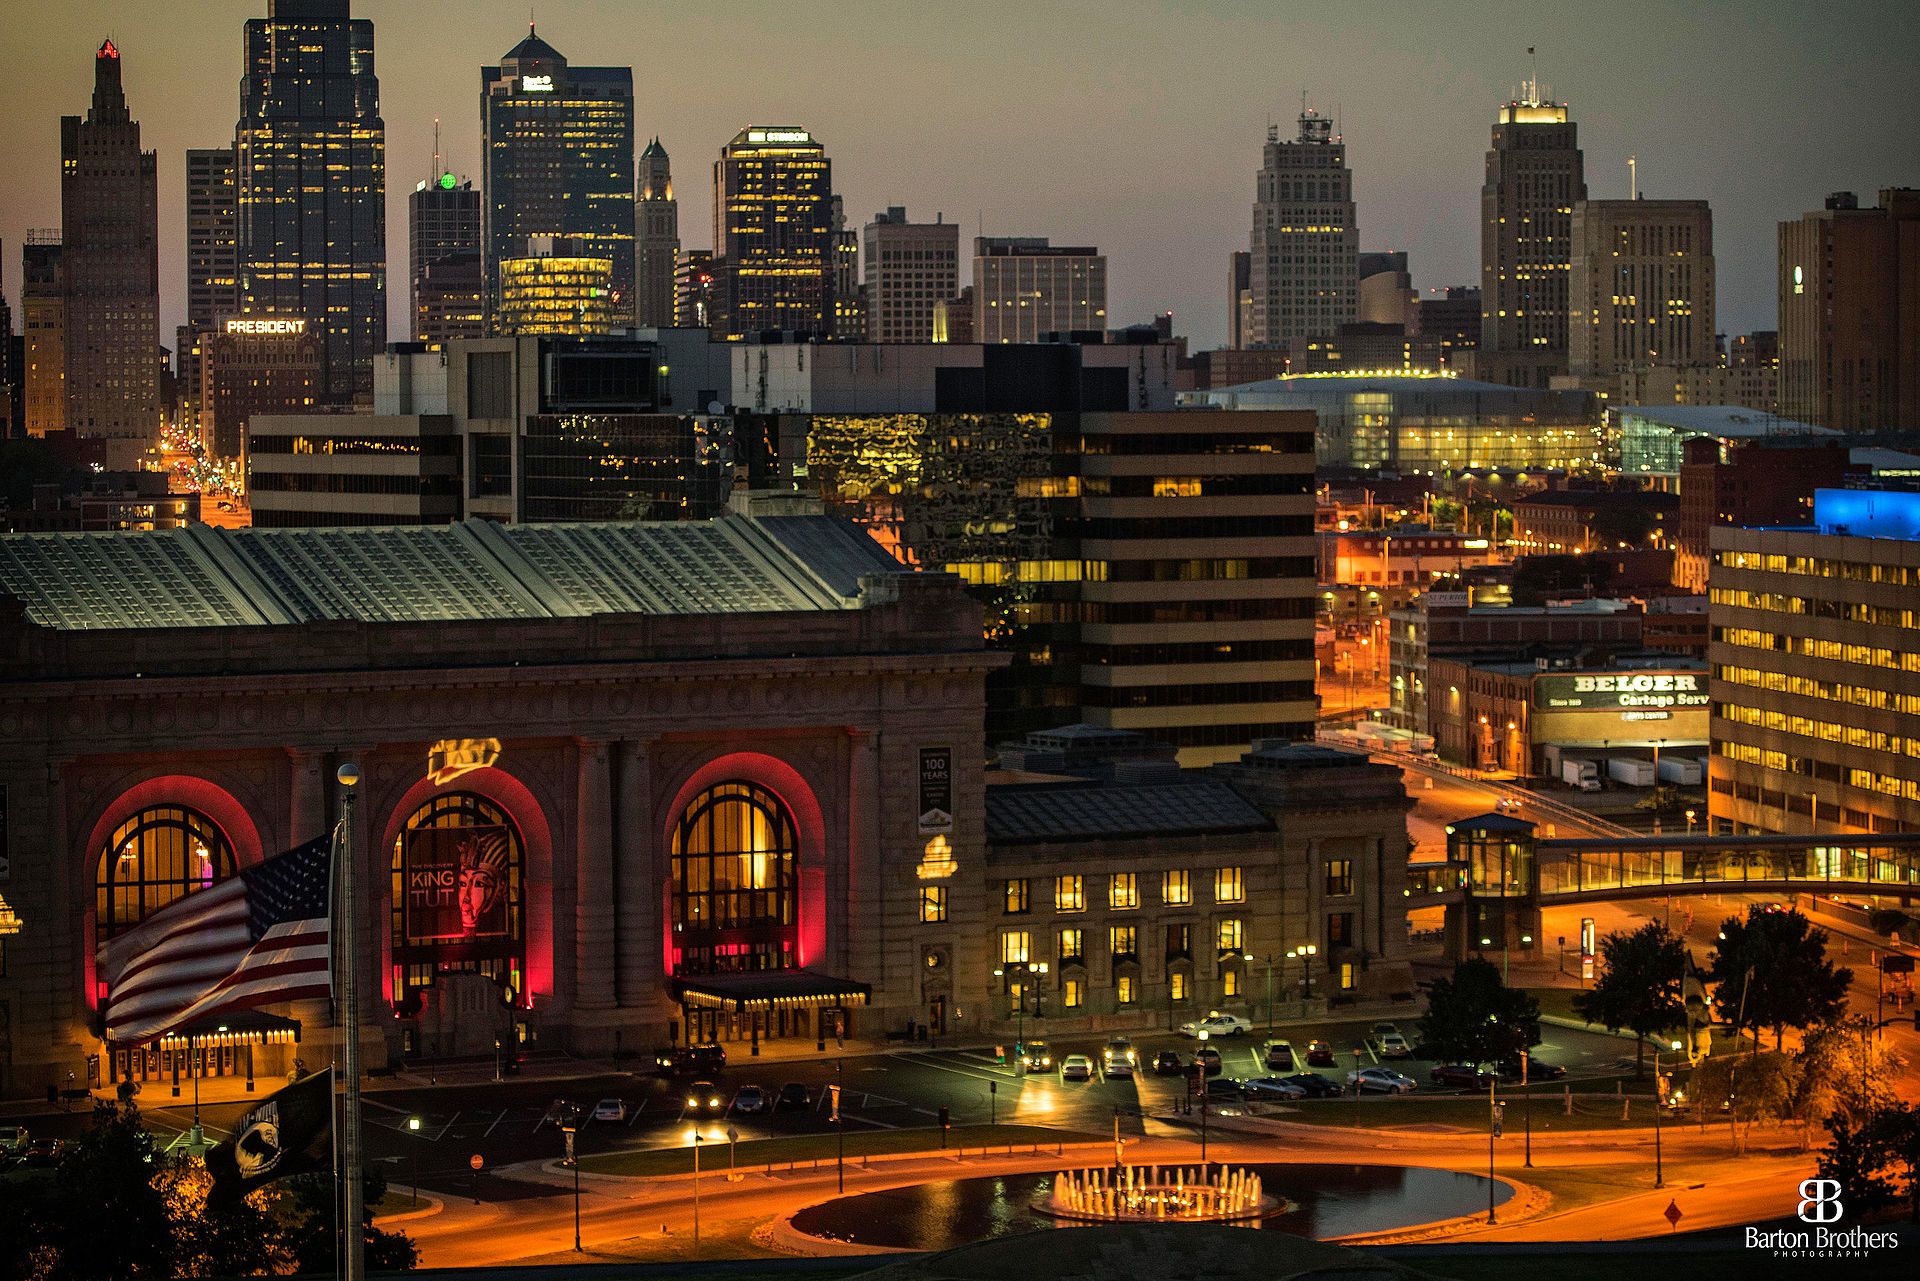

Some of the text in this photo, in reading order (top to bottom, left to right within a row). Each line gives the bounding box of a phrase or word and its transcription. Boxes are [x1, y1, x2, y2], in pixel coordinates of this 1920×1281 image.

[226, 320, 305, 334] PRESIDENT
[1575, 675, 1698, 692] BELGER
[1618, 693, 1674, 708] Cartage
[925, 758, 945, 770] 100
[922, 771, 949, 780] YEARS
[411, 888, 454, 908] TUT
